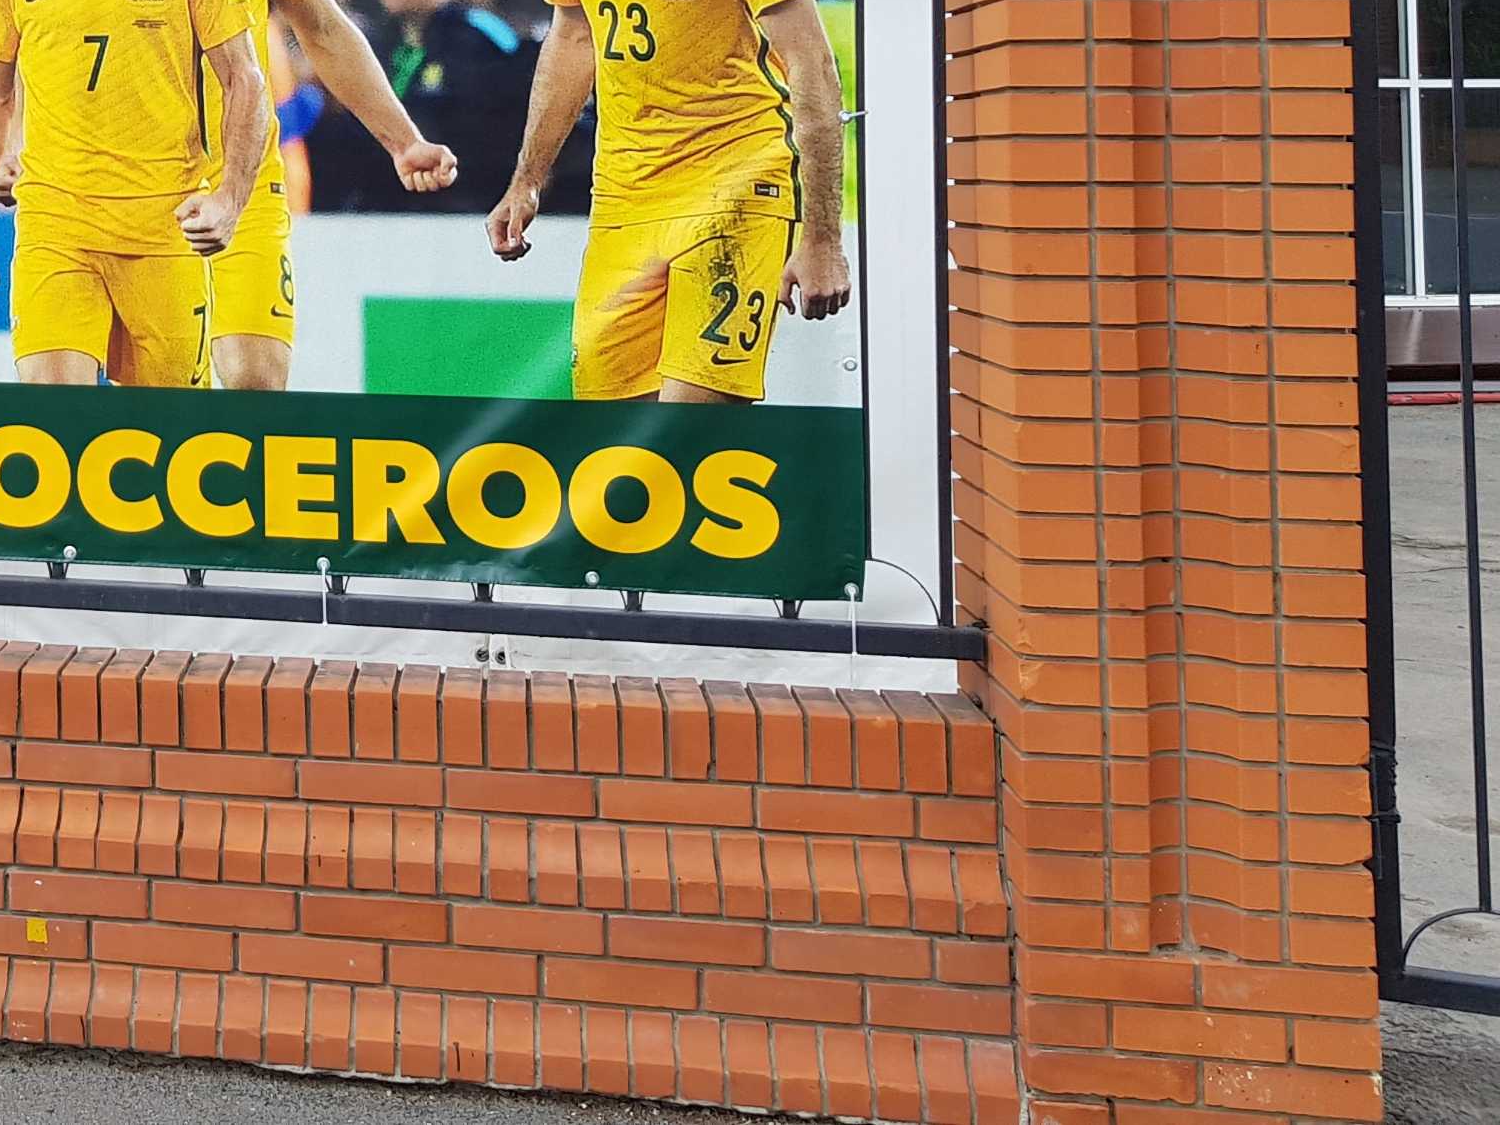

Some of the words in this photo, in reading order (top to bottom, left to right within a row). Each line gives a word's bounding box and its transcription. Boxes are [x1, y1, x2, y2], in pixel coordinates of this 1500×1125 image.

[599, 0, 656, 62] 23
[83, 34, 109, 92] 7
[699, 281, 765, 352] 23
